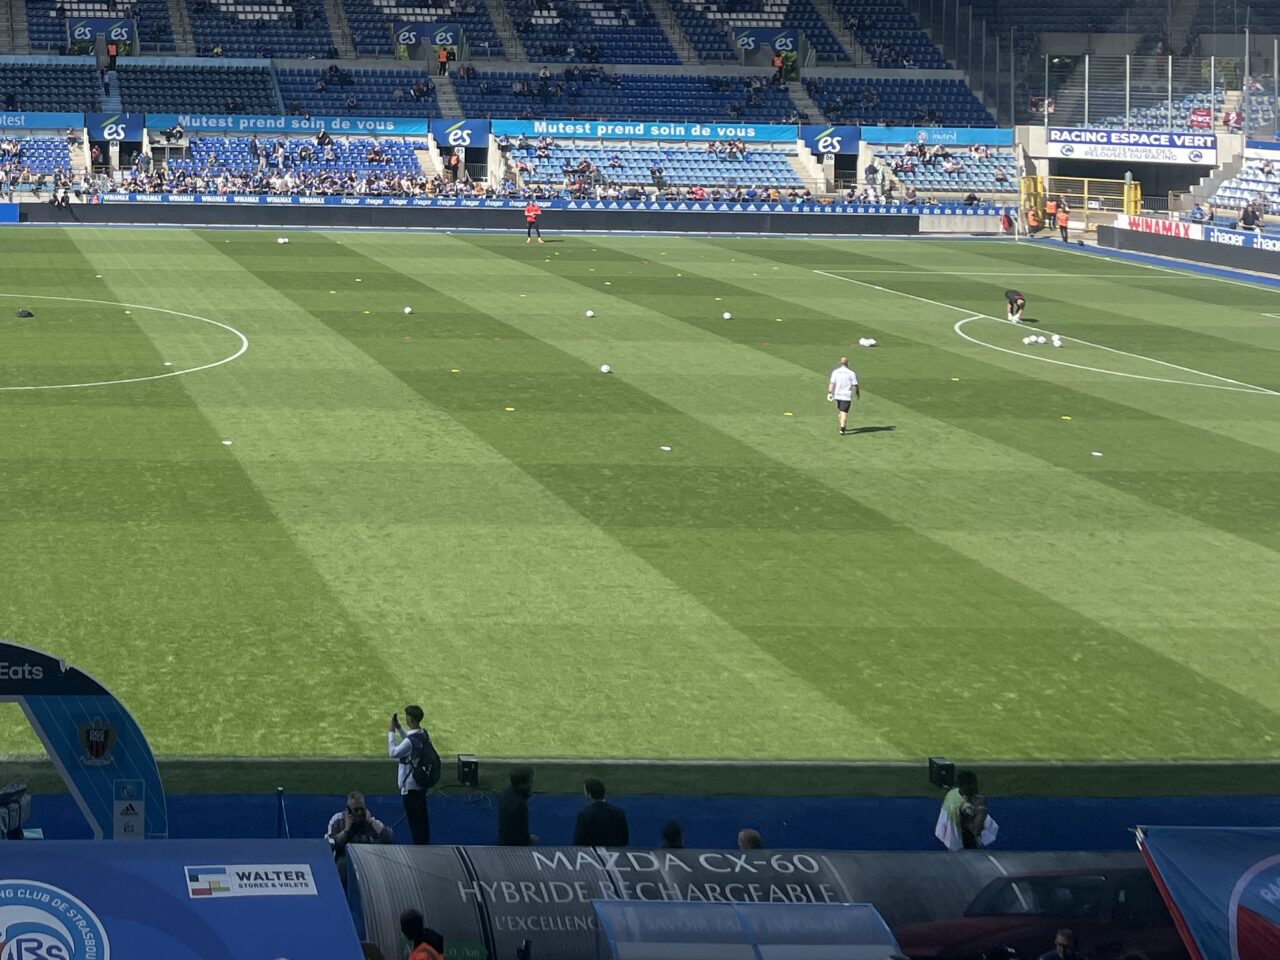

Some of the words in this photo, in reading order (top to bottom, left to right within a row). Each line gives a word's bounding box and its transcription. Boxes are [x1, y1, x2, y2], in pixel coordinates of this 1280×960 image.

[179, 115, 232, 128] Mutest
[240, 116, 285, 132] prend
[291, 117, 325, 129] soin
[332, 118, 350, 130] de
[357, 120, 394, 130] vous
[534, 121, 589, 134] Mutest
[597, 123, 644, 138] prend
[650, 123, 685, 136] soin
[690, 124, 710, 136] de
[717, 127, 755, 137] vous
[1050, 130, 1107, 143] RACING
[1111, 133, 1170, 146] ESPACE
[1173, 135, 1214, 148] VERT
[104, 194, 129, 202] WINAMAX
[136, 194, 162, 202] WINAMAX
[169, 195, 194, 203] WINAMAX
[234, 196, 259, 204] WINAMAX
[267, 196, 292, 204] WINAMAX
[1128, 216, 1190, 239] WINAMAX
[532, 851, 692, 873] MAZDA
[699, 853, 820, 874] CX-60
[236, 871, 306, 881] WALTER
[457, 880, 588, 903] HYBRIDE
[599, 880, 835, 904] RECHARGEABLE
[17, 889, 49, 903] CLUB
[51, 899, 69, 912] DE
[66, 908, 97, 960] STRASBOU
[495, 915, 598, 931] L'EXCELLENC
